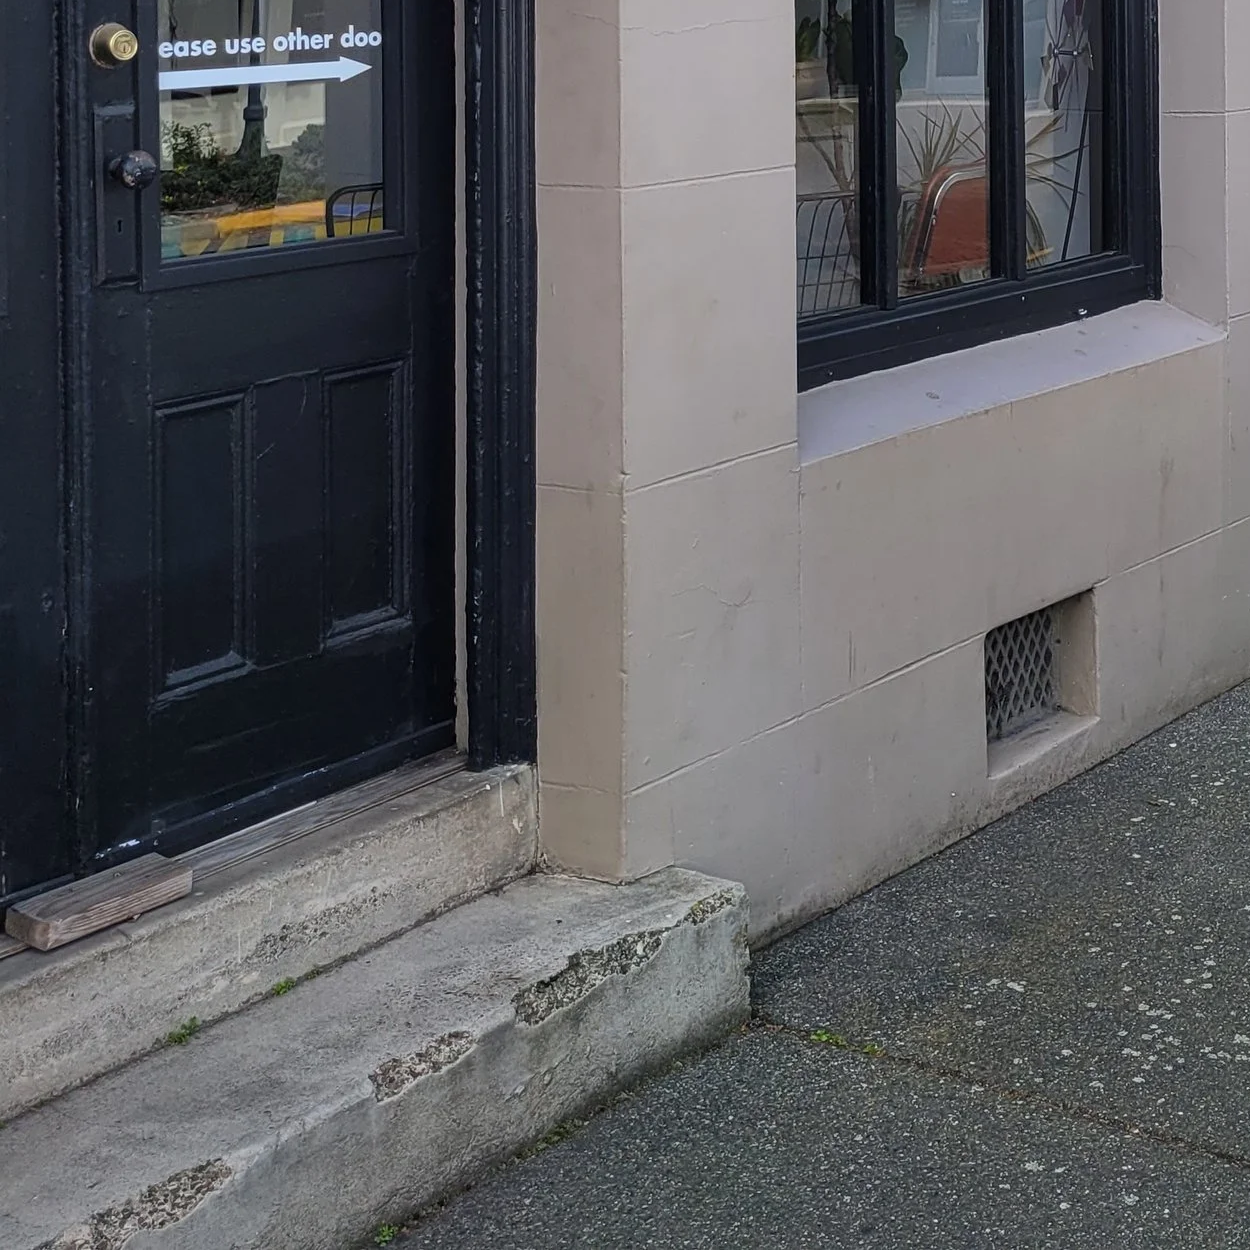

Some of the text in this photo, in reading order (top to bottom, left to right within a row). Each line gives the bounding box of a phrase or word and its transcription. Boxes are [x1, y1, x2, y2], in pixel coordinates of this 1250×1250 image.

[158, 24, 382, 59] ease use other doo
